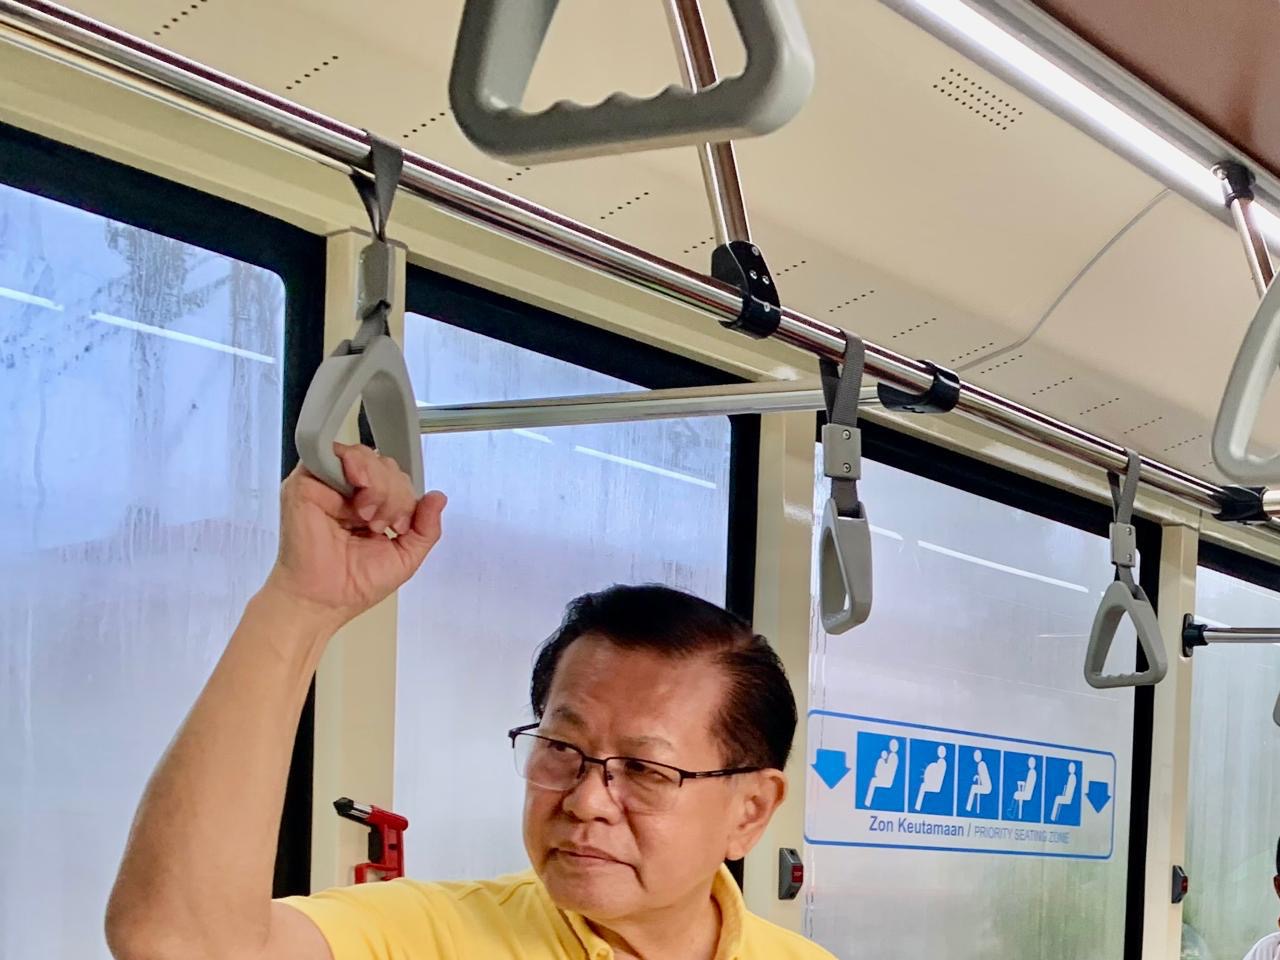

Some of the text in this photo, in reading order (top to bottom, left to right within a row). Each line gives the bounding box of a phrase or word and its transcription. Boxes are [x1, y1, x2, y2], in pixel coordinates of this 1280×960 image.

[869, 816, 893, 832] Zon
[898, 817, 964, 836] Keutamaan
[974, 826, 1013, 839] PRIORITY
[1014, 829, 1046, 842] SEATING
[1048, 831, 1070, 844] ZONE
